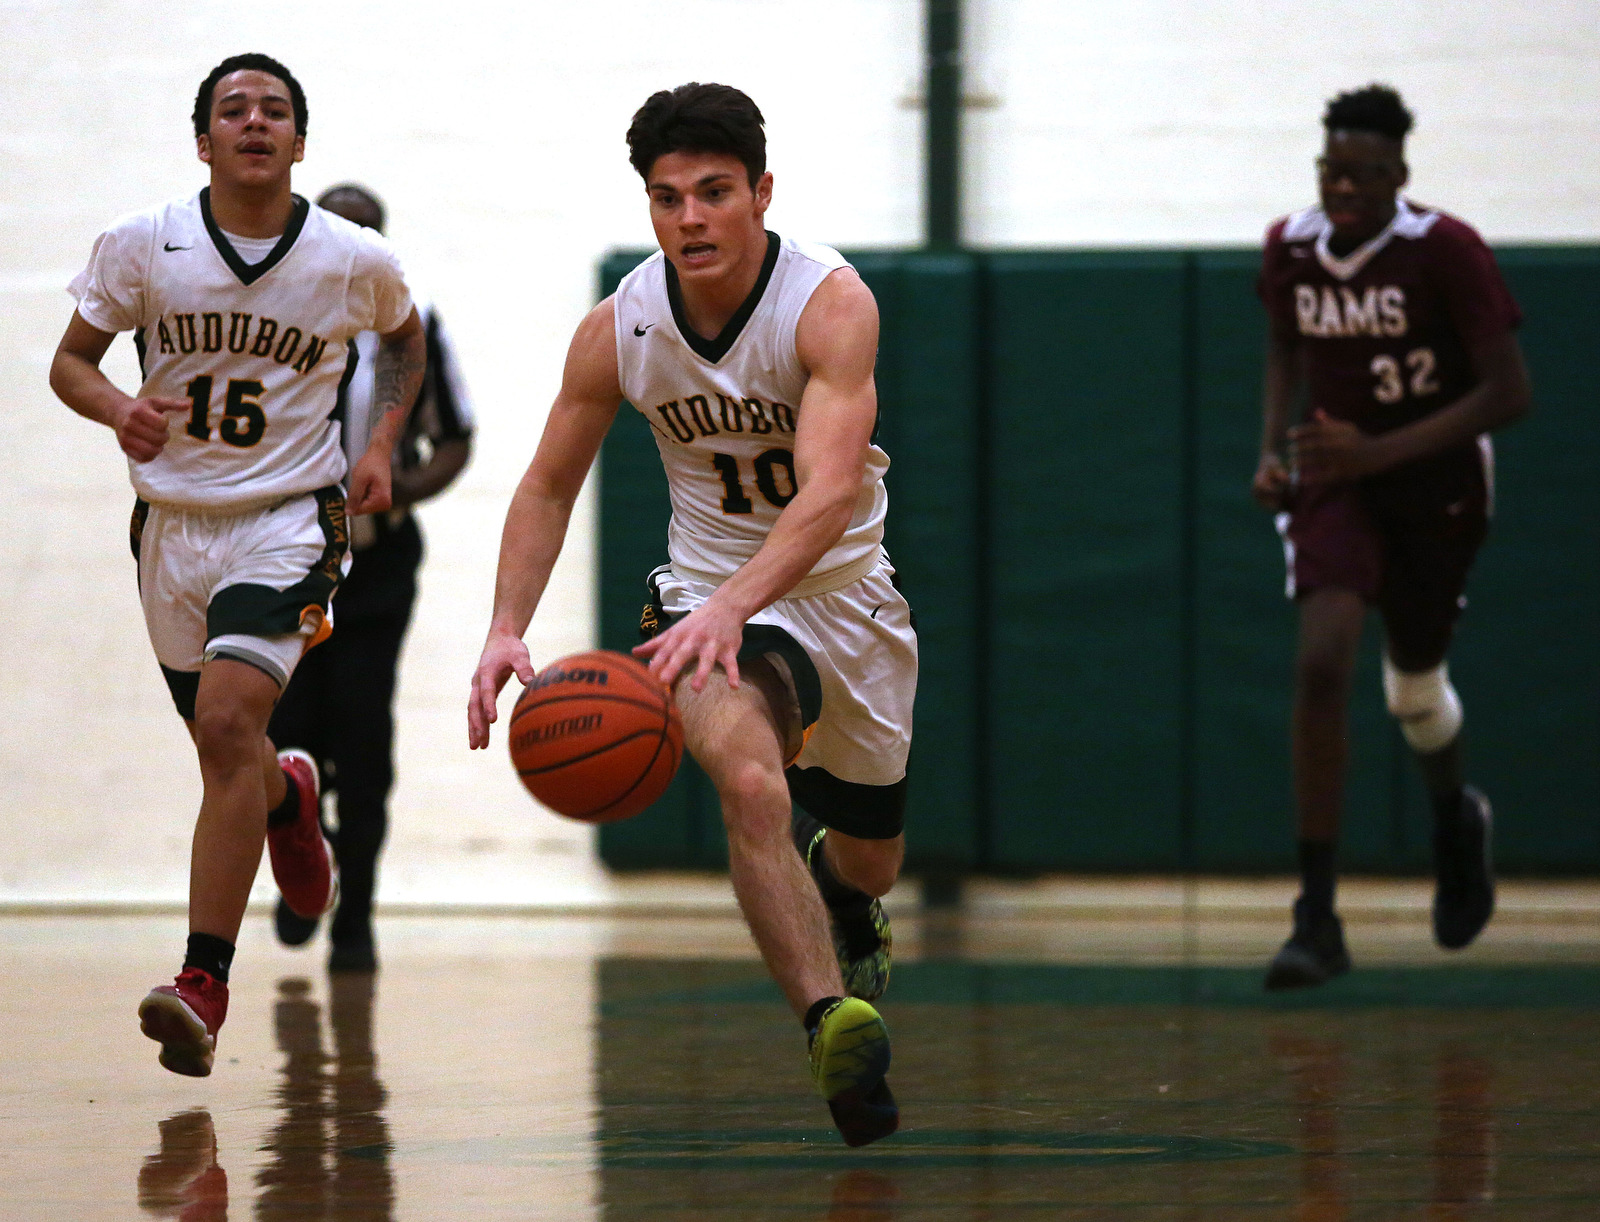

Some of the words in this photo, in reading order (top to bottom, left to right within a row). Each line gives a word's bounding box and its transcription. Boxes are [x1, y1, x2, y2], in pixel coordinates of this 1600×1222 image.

[1294, 284, 1409, 338] RAMS
[157, 311, 329, 375] AUDUBON
[1370, 347, 1440, 404] 32
[185, 374, 268, 449] 15
[645, 392, 797, 444] UDUBO
[711, 447, 798, 516] 10
